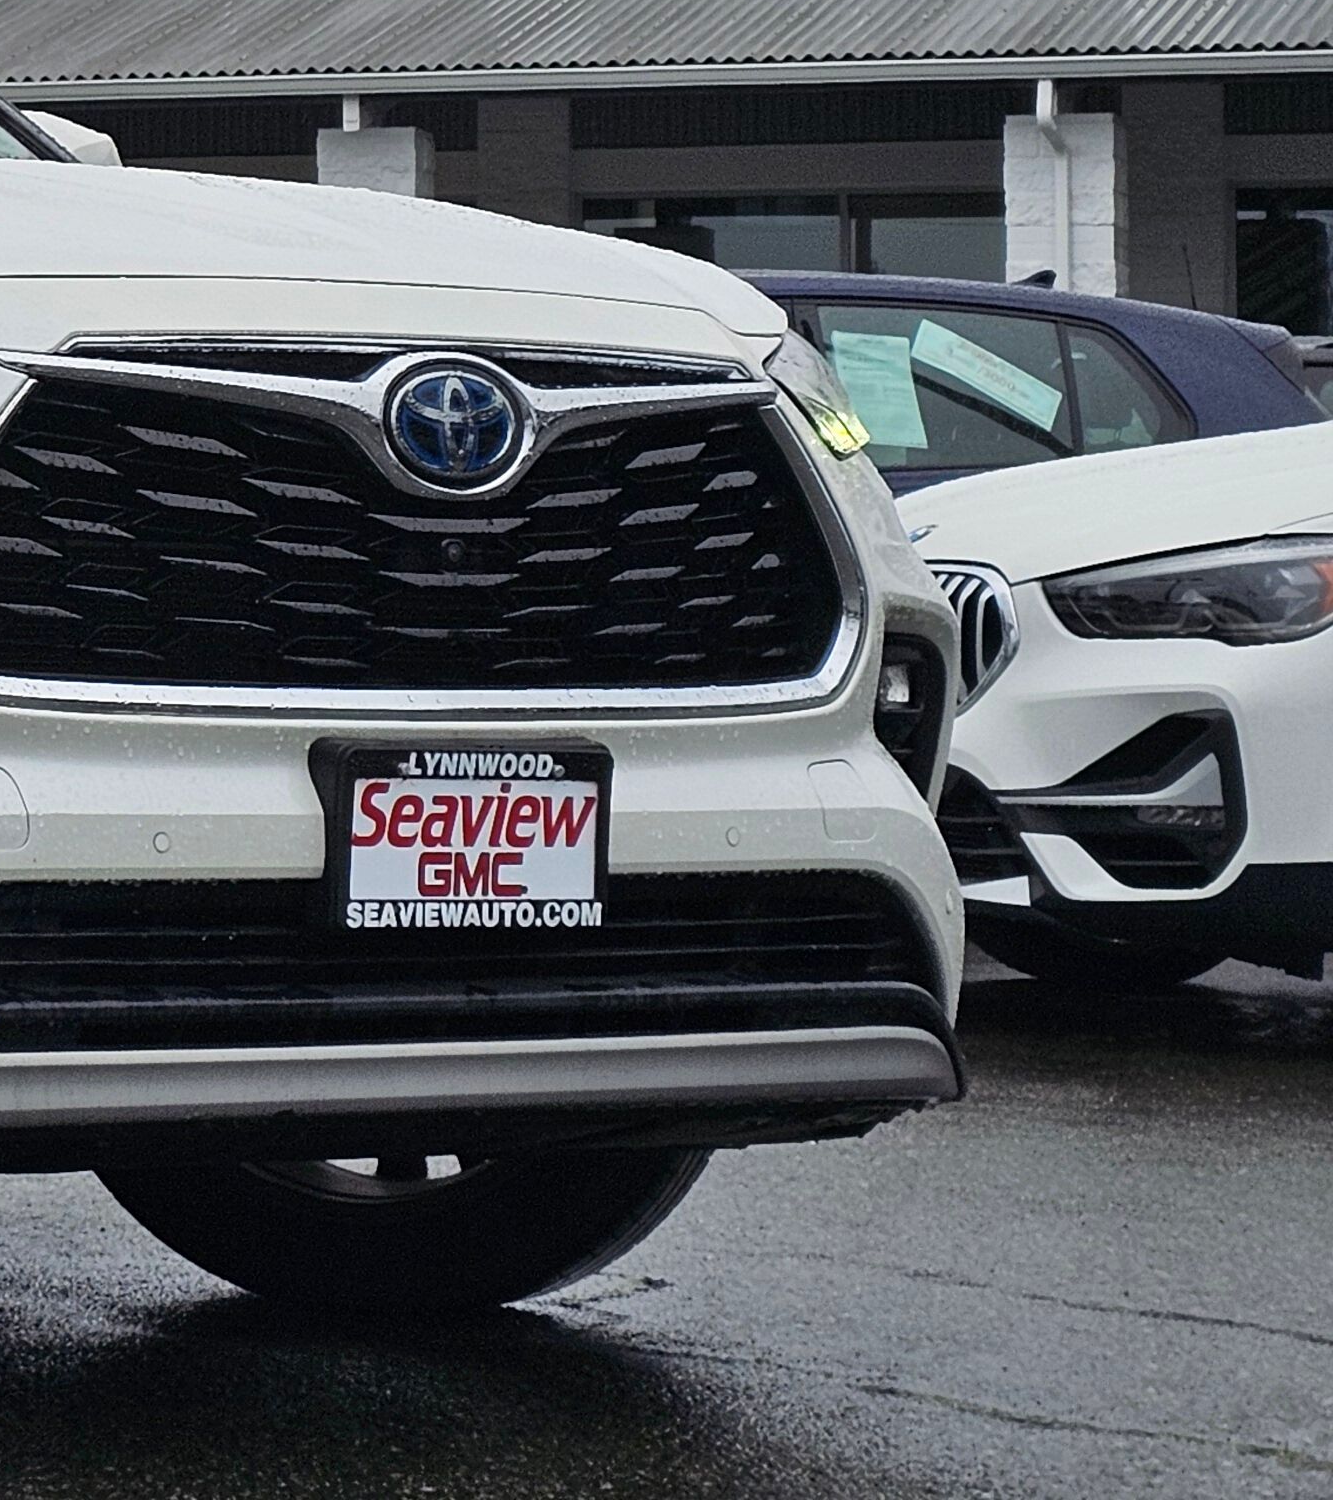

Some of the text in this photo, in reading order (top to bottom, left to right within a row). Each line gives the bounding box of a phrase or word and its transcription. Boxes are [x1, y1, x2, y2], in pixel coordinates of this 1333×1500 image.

[408, 752, 554, 778] LYNNWOOD
[351, 782, 597, 848] Seaview
[418, 852, 528, 897] GMC
[346, 902, 603, 928] SEAVIEWAUTO.COM
